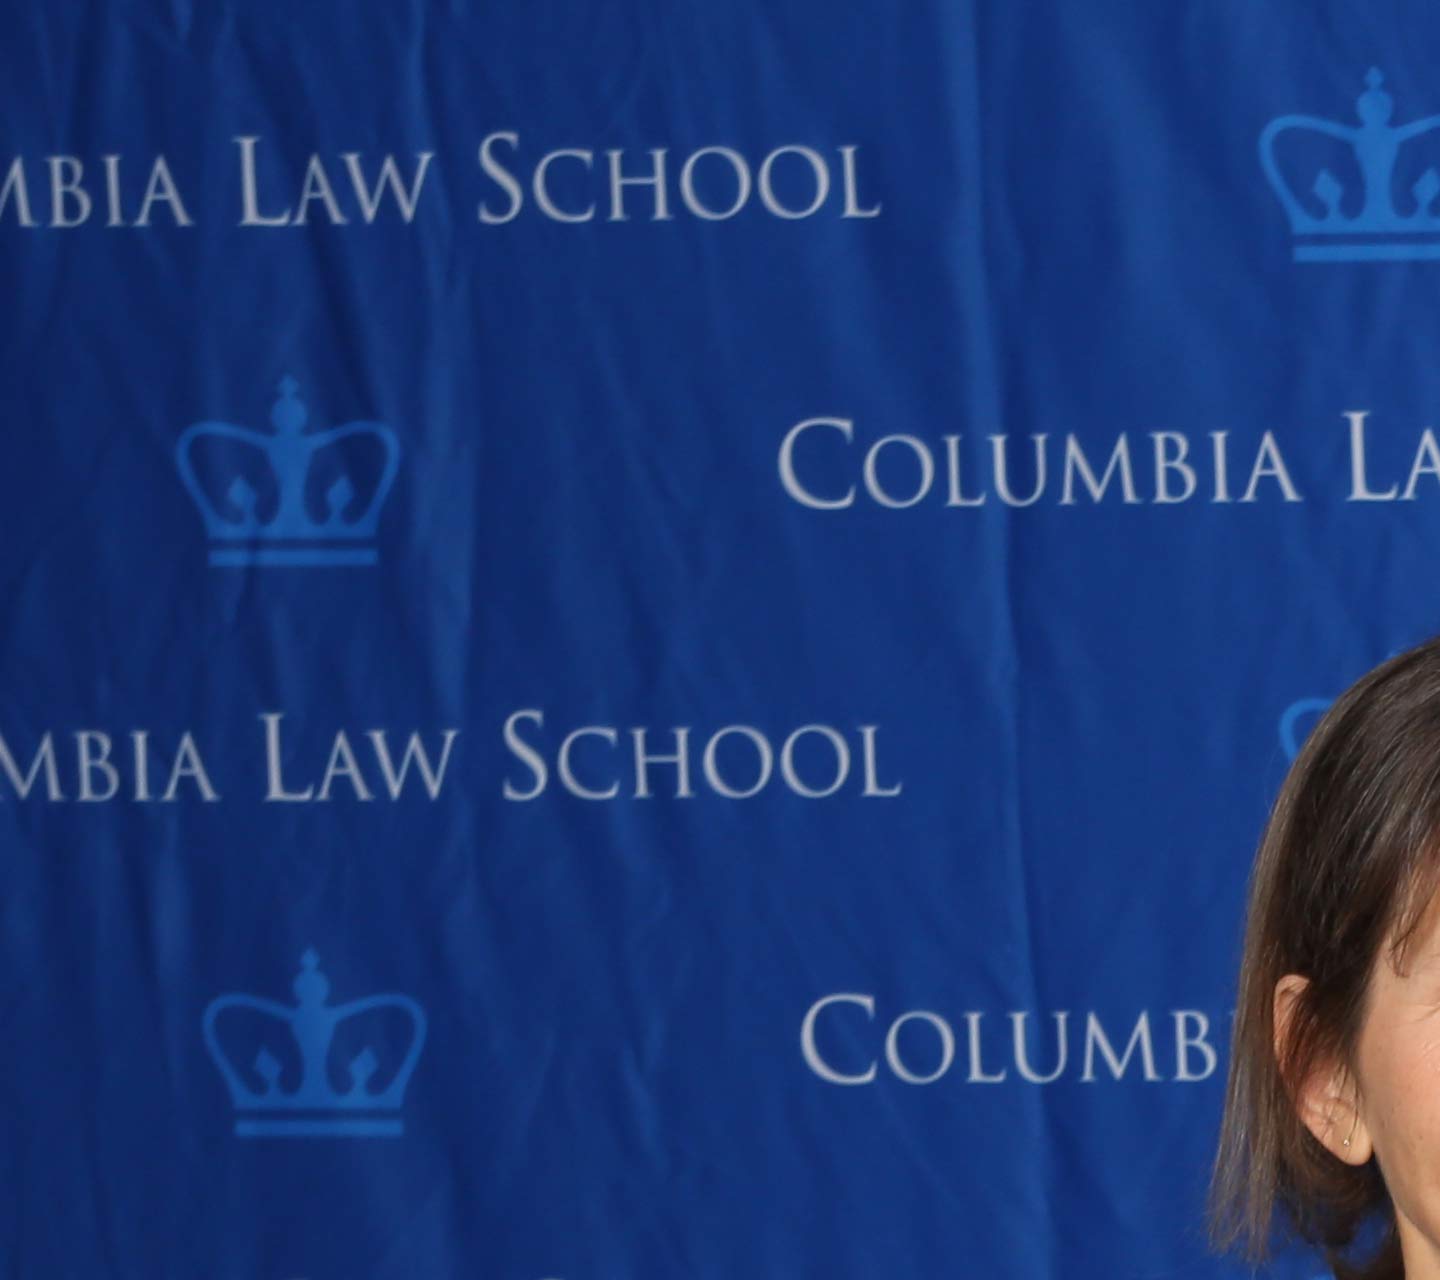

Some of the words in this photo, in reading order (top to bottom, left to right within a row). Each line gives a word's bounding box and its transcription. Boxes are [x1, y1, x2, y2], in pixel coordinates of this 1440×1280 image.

[233, 134, 436, 227] LAW
[477, 129, 882, 225] SCHOOL
[777, 415, 1303, 510] COLUMBIA
[260, 711, 459, 802] LAW
[501, 707, 903, 802] SCHOOL
[800, 994, 1235, 1085] COLUMB
